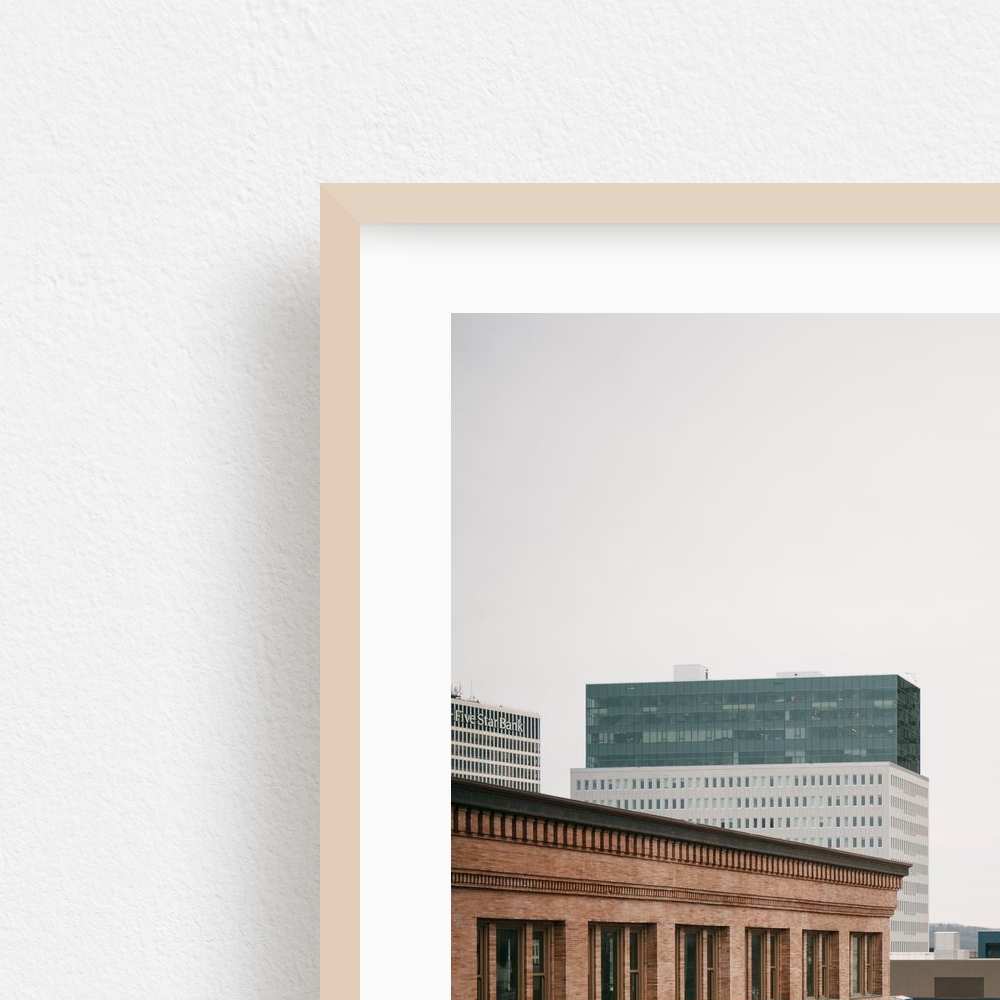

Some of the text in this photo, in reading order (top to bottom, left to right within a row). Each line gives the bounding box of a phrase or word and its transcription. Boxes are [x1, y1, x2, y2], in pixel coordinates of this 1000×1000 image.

[455, 710, 523, 732] Five Star Bank
